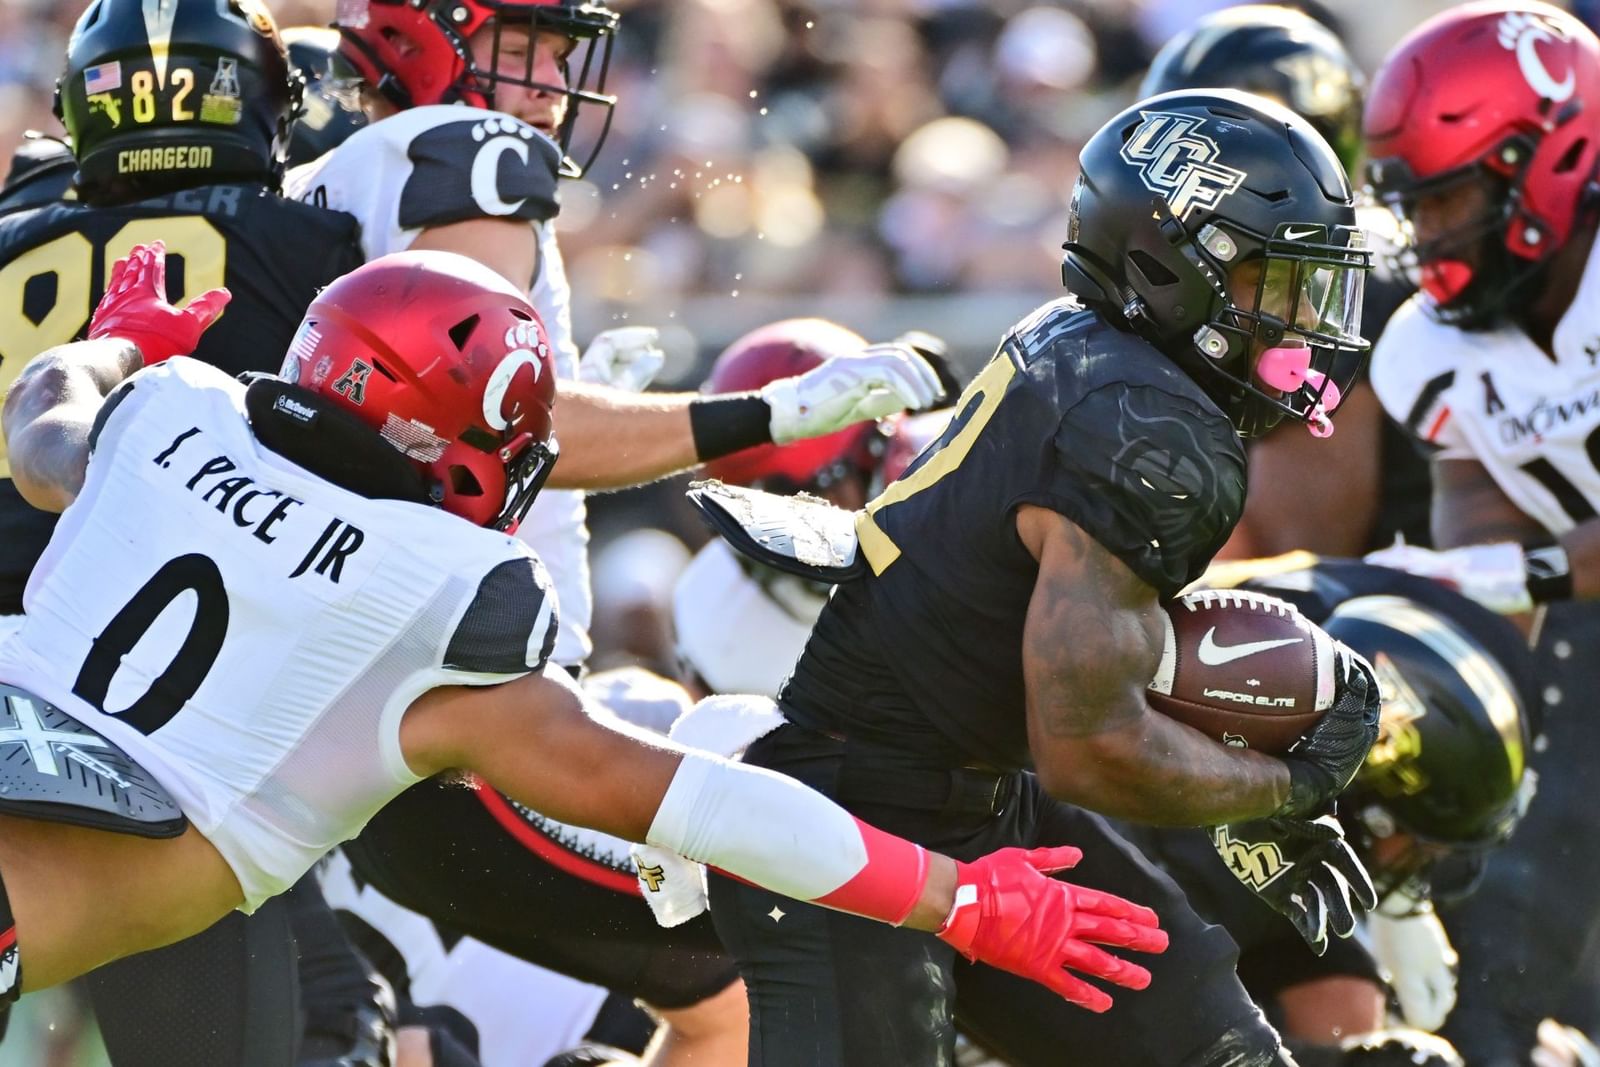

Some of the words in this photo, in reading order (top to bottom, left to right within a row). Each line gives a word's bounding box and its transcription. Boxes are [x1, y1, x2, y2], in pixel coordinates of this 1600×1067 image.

[131, 68, 195, 123] 82
[118, 146, 213, 174] CHARGEON
[471, 135, 529, 216] C
[1120, 110, 1248, 222] UCF
[331, 357, 374, 406] A
[483, 348, 543, 431] C
[185, 455, 304, 545] PACE
[288, 517, 365, 584] JR
[71, 552, 230, 737] 0
[1203, 687, 1254, 705] VAPOR
[1255, 696, 1295, 707] ELITE
